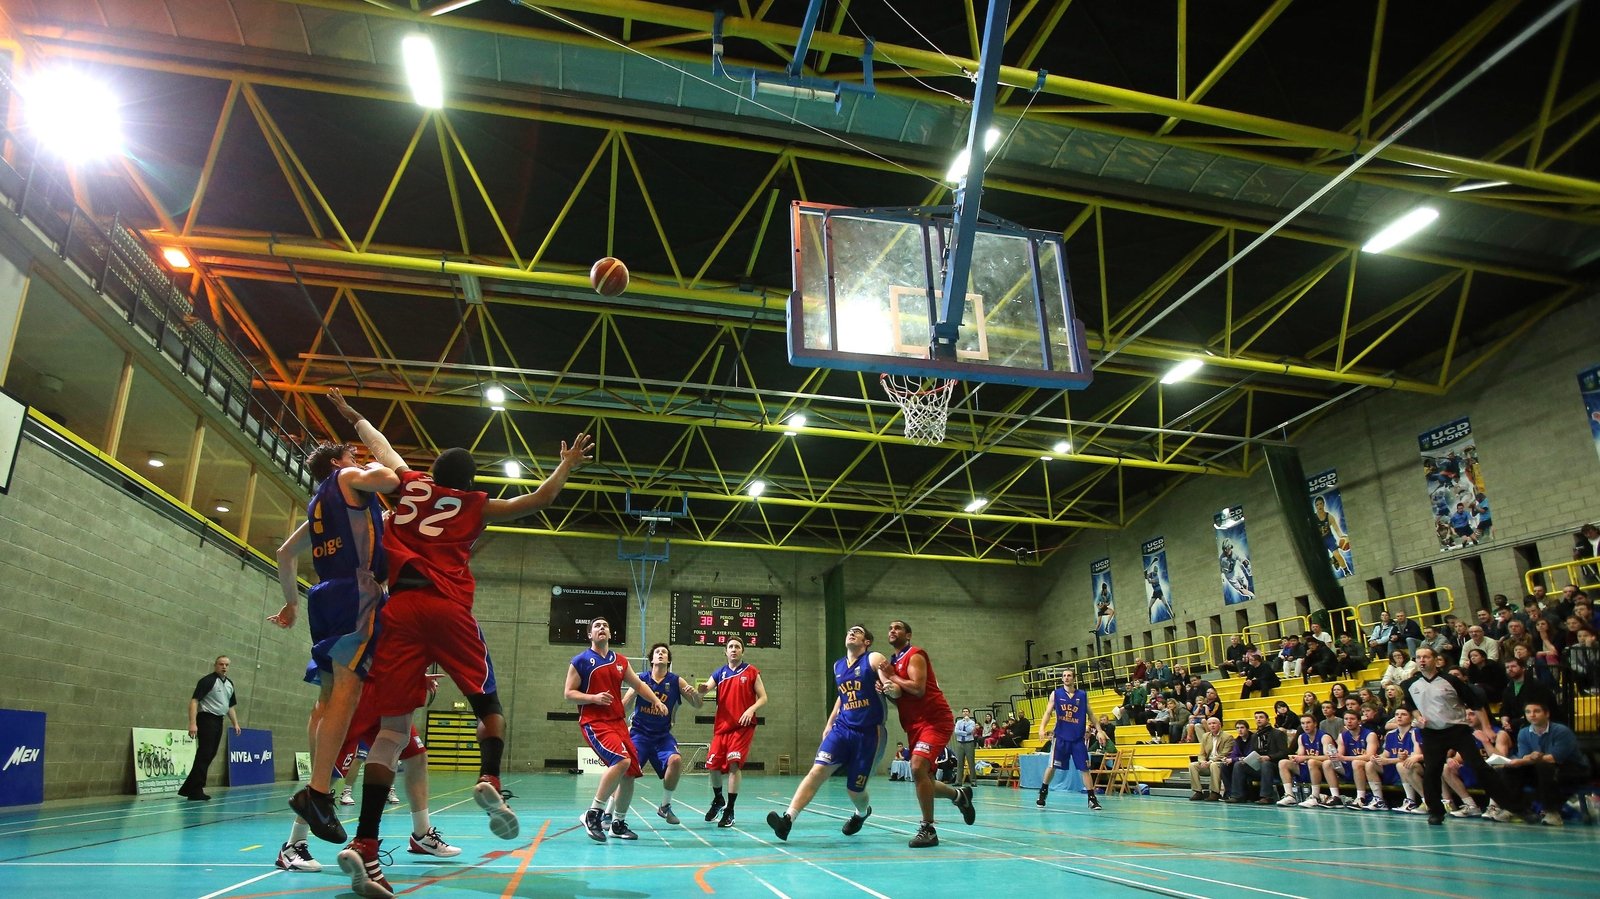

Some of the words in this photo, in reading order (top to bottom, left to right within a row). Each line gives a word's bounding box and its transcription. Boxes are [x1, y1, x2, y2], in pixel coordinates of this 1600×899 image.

[1431, 421, 1470, 440] UCD
[1432, 427, 1471, 447] SPORT
[1308, 472, 1337, 487] UCD
[1309, 479, 1337, 492] SPORT
[394, 481, 462, 537] 32
[1146, 538, 1165, 549] UCD
[1147, 543, 1165, 553] SPORT
[1095, 559, 1109, 568] UCD
[1095, 564, 1110, 572] SPORT
[562, 588, 627, 596] VOLLEYBALLIRELAND.COM
[713, 598, 740, 608] 04:10
[700, 616, 713, 626] 38
[742, 618, 755, 627] 28
[590, 657, 596, 666] 9
[839, 681, 862, 694] UCD
[847, 691, 858, 701] 21
[1060, 703, 1079, 713] UCD
[3, 745, 40, 771] MEN
[230, 751, 253, 763] NIVEA
[260, 749, 272, 765] MEN
